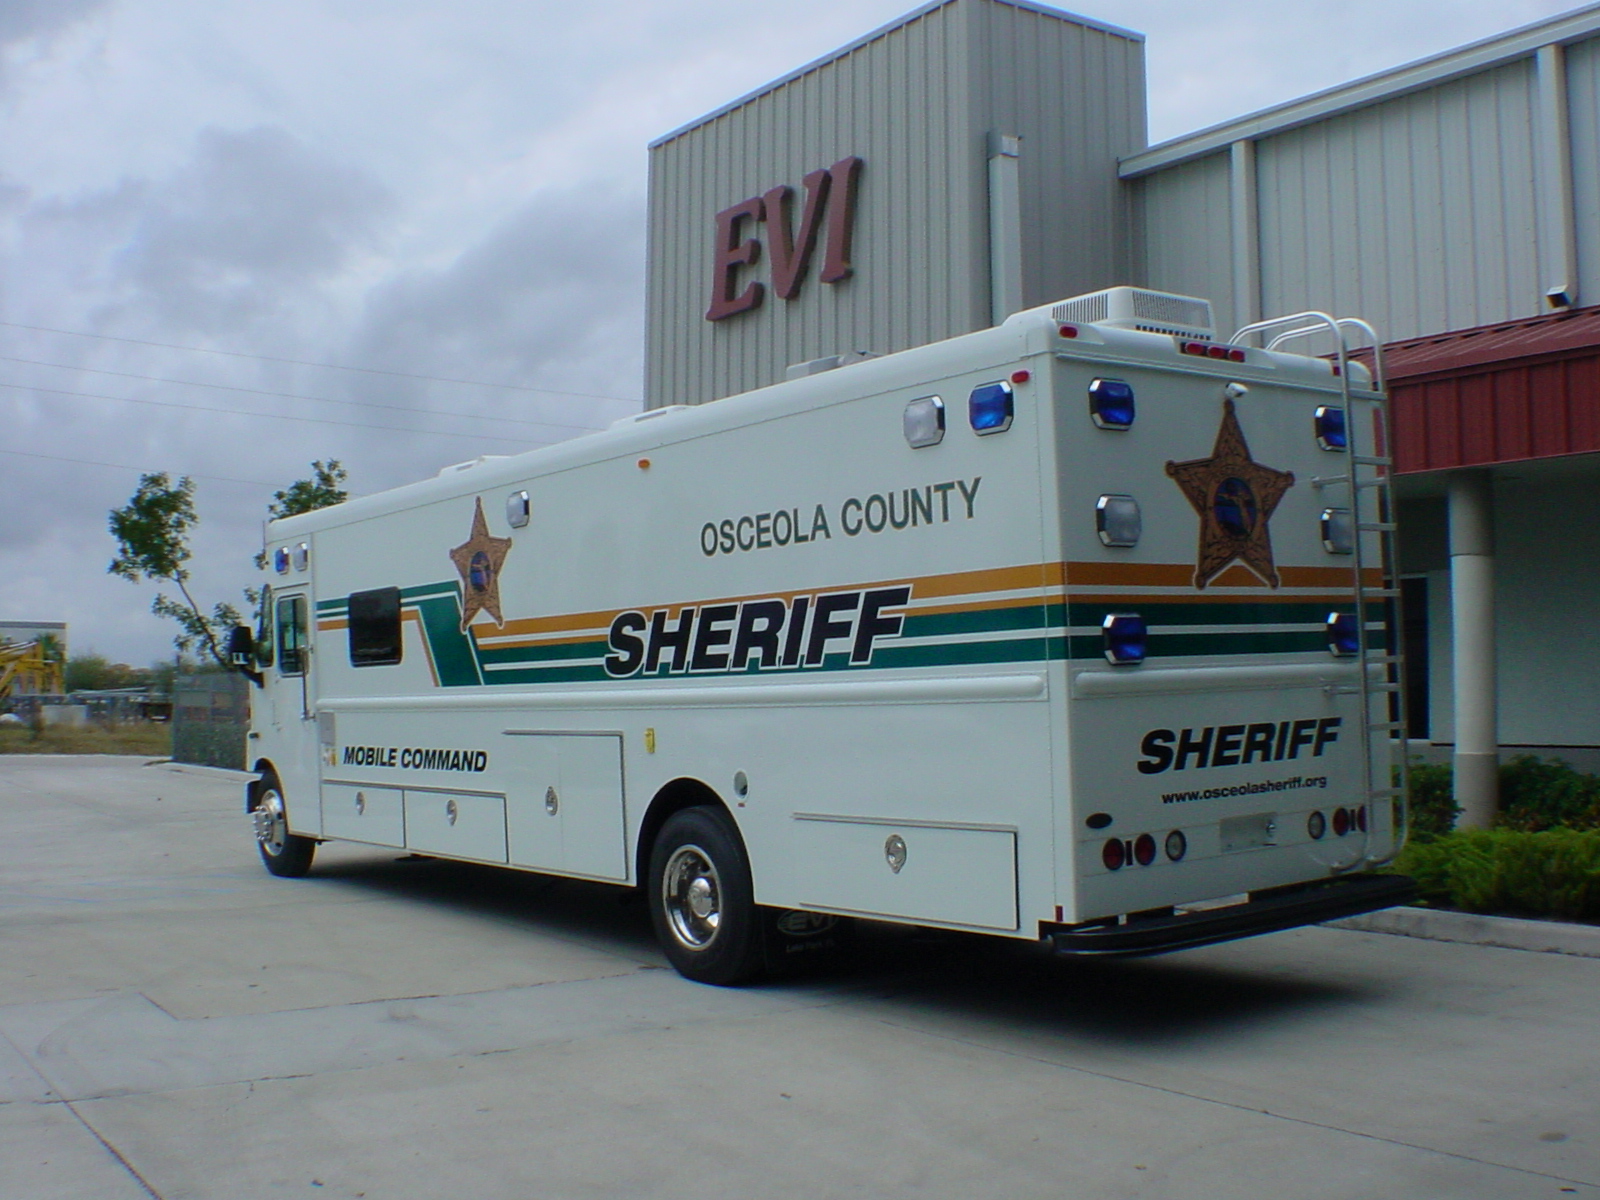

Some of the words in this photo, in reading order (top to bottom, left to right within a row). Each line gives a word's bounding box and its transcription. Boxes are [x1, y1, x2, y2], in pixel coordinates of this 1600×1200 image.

[705, 156, 863, 321] EVI
[701, 504, 831, 556] OSCEOLA
[841, 477, 981, 536] COUNTY
[604, 584, 913, 677] SHERIFF
[343, 746, 398, 767] MOBILE
[401, 748, 487, 772] COMMAND
[1137, 717, 1342, 774] SHERIFF
[1162, 776, 1327, 804] www.osceolasheriff.org
